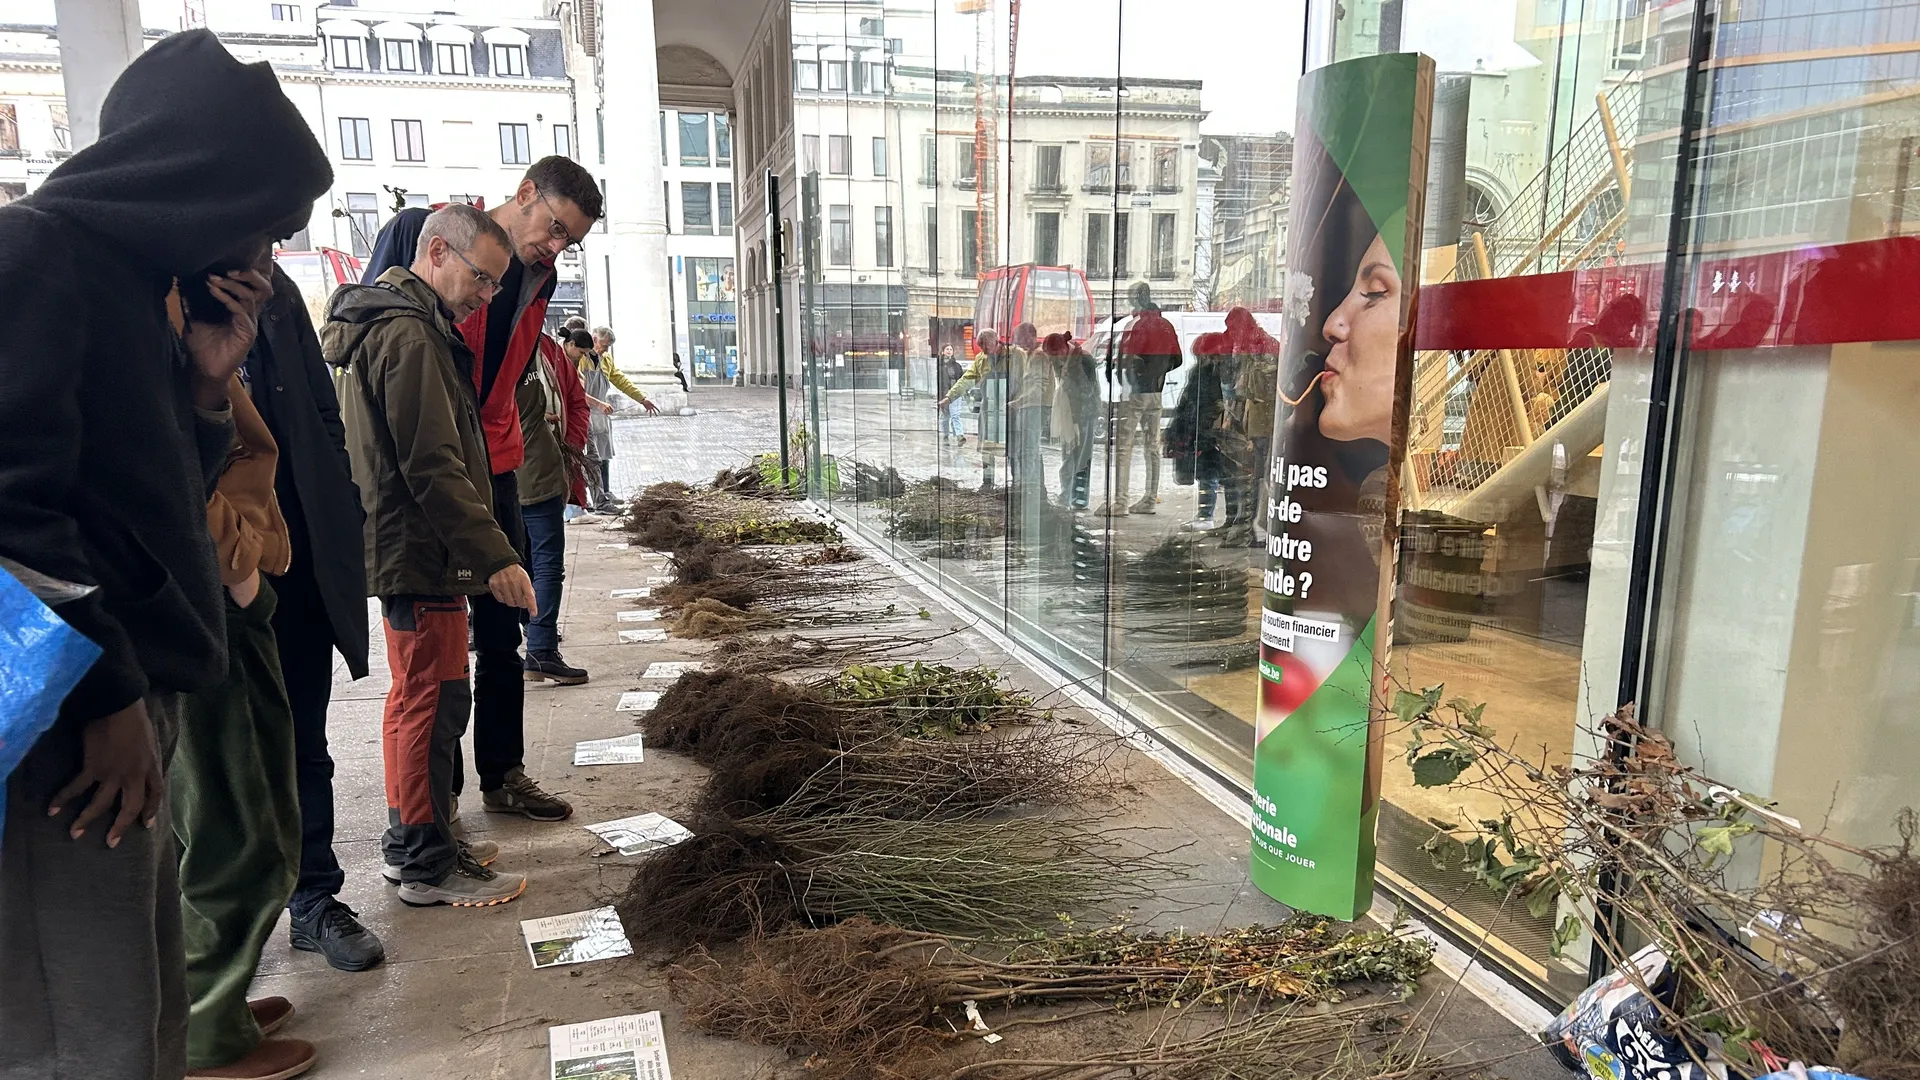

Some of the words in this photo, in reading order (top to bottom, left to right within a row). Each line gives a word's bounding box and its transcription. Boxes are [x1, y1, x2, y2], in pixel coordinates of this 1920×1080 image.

[1287, 463, 1328, 492] pas
[1278, 495, 1302, 523] de
[1268, 532, 1312, 562] votre
[1298, 571, 1313, 599] ?
[1267, 615, 1290, 630] soutien
[1292, 620, 1336, 638] financier
[1268, 844, 1283, 858] QUE
[1285, 853, 1316, 869] JOUER
